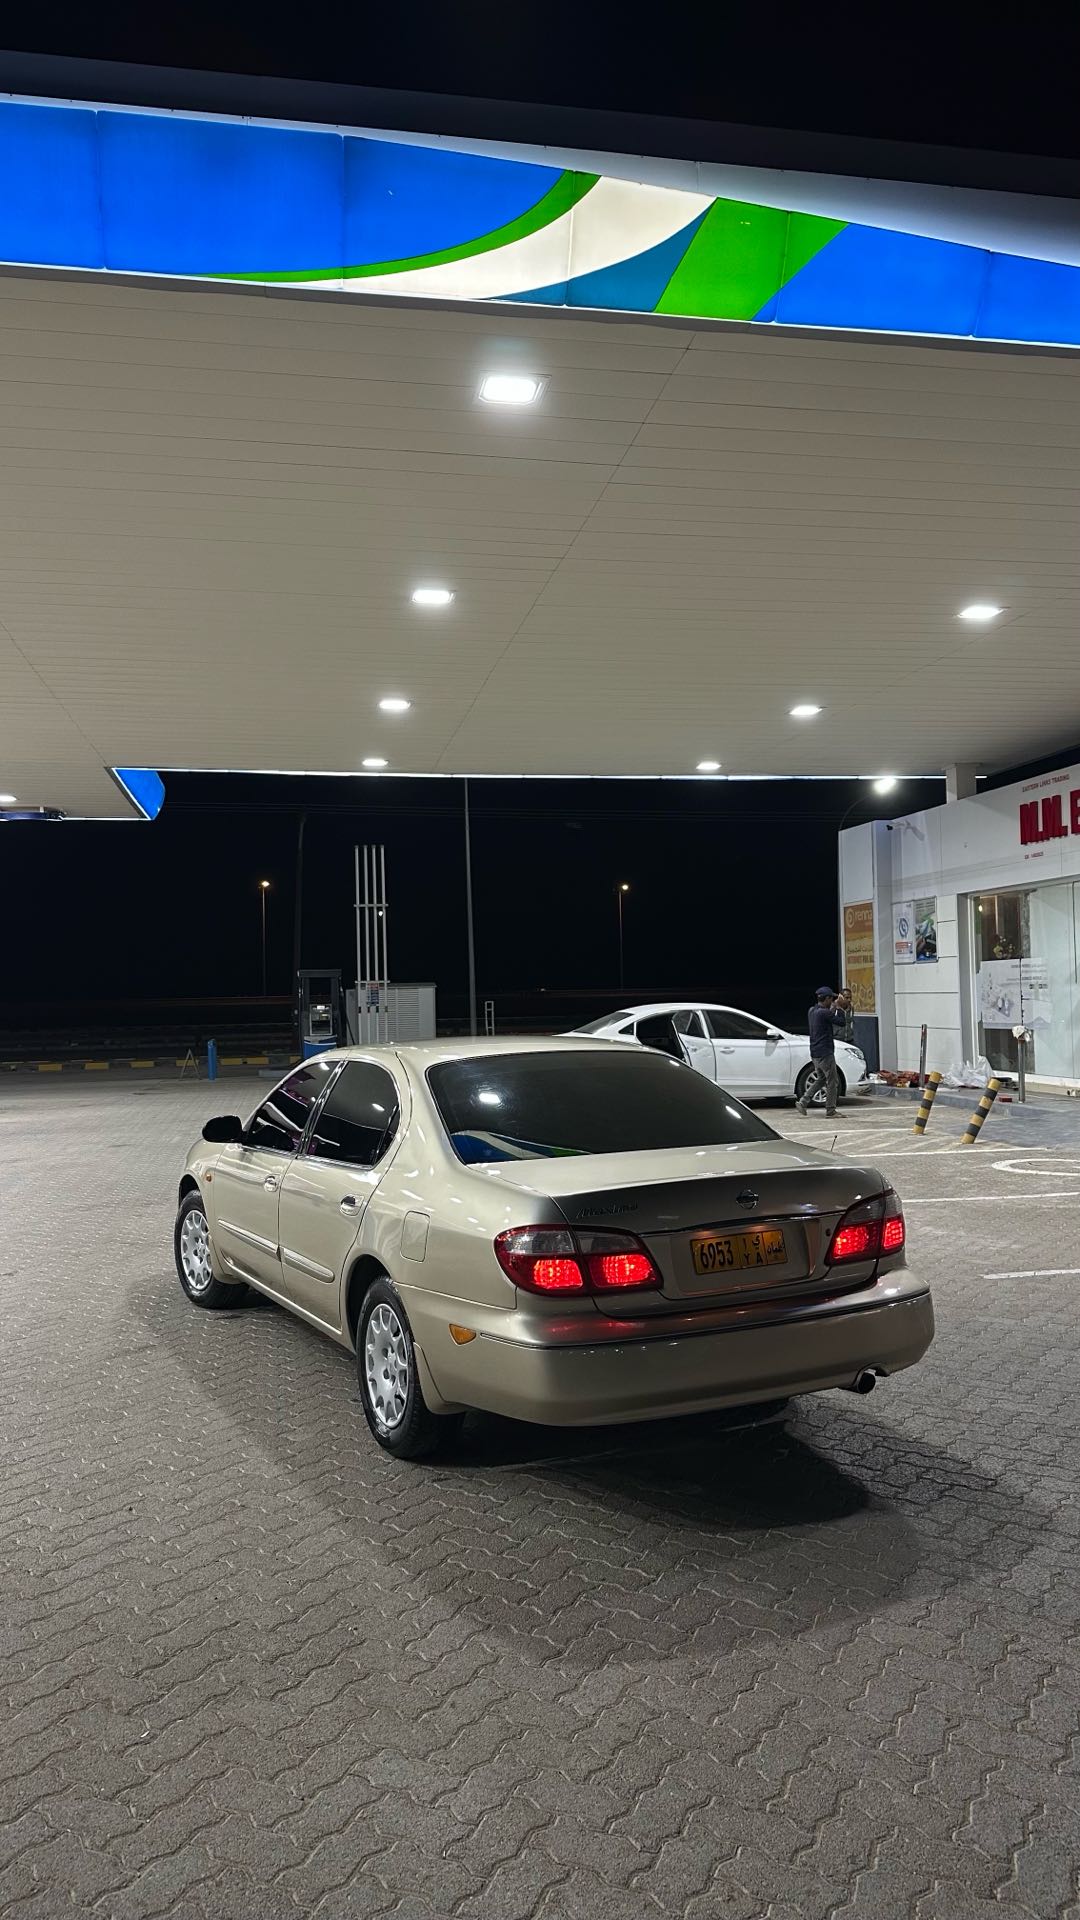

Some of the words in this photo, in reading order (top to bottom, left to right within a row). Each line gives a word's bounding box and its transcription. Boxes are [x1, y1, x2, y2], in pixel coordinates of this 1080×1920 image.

[700, 1240, 734, 1269] 6953
[744, 1253, 750, 1265] Y
[757, 1252, 764, 1264] A
